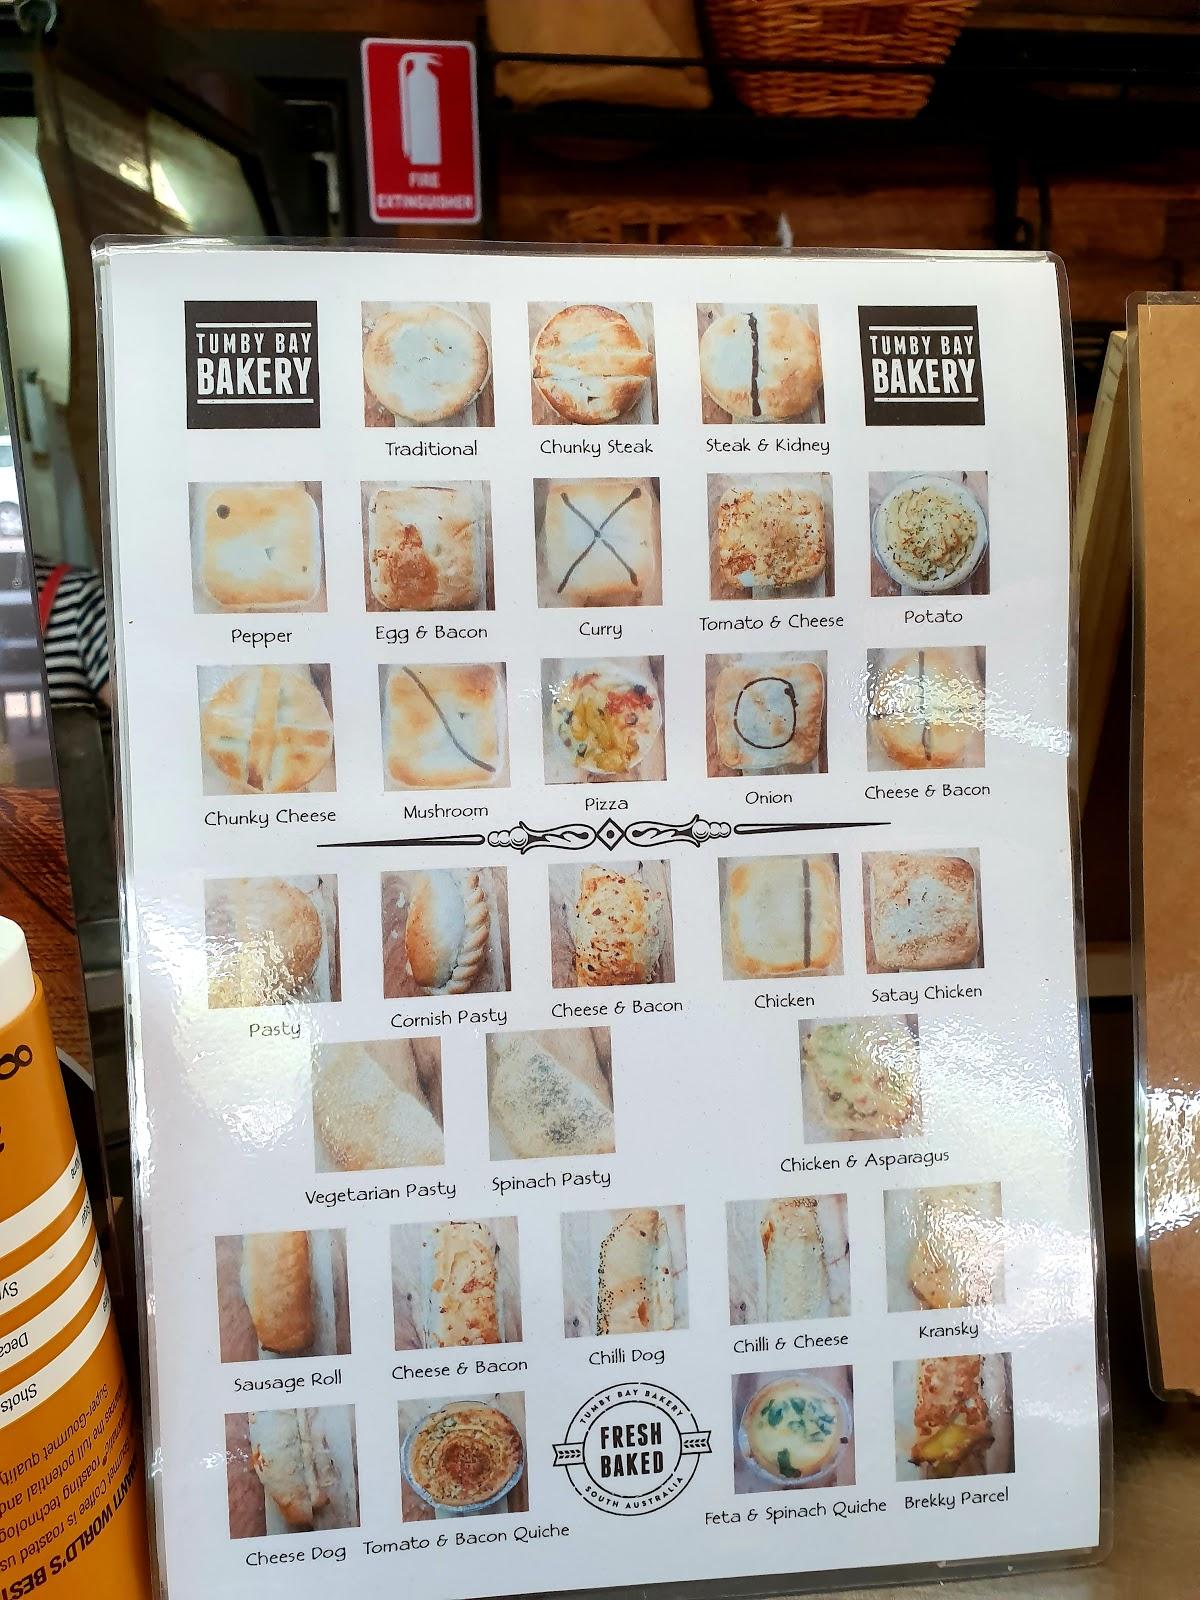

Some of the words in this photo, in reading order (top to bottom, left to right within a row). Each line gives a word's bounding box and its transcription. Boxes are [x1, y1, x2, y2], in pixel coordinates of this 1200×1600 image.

[408, 171, 440, 188] FIRE
[376, 193, 474, 210] EXTINGUISHER
[195, 332, 265, 354] TUMBY
[275, 332, 312, 354] BAY
[869, 335, 931, 355] TUMBY
[940, 335, 974, 355] BAY
[197, 357, 312, 395] BAKERY
[871, 358, 976, 394] BAKERY
[384, 439, 478, 457] Traditional
[539, 438, 601, 458] Chunky
[607, 438, 654, 454] Steak
[705, 437, 752, 453] Steak
[757, 438, 770, 452] &
[775, 436, 830, 456] Kidney
[698, 615, 764, 632] Tomato
[769, 615, 782, 629] &
[788, 612, 844, 629] Cheese
[904, 608, 963, 624] Potato
[231, 628, 293, 649] Pepper
[375, 625, 410, 645] Egg
[415, 625, 429, 640] &
[434, 624, 488, 639] Bacon
[579, 621, 623, 640] Curry
[745, 791, 793, 805] Onion
[864, 785, 919, 800] Cheese
[924, 784, 937, 798] &
[942, 783, 991, 797] Bacon
[403, 803, 489, 820] Mushroom
[585, 797, 629, 812] Pizza
[204, 809, 269, 829] Chunky
[275, 808, 337, 824] Cheese
[754, 992, 815, 1009] Chicken
[871, 987, 919, 1005] Satay
[923, 983, 983, 1000] Chicken
[390, 1009, 452, 1029] Cornish
[458, 1007, 508, 1026] Pasty
[551, 1002, 608, 1018] Cheese
[613, 1000, 626, 1015] &
[632, 999, 683, 1014] Bacon
[249, 1021, 301, 1040] Pasty
[780, 1155, 841, 1173] Chicken
[846, 1154, 858, 1169] &
[863, 1151, 950, 1171] Asparagus
[492, 1172, 556, 1192] Spinach
[561, 1169, 611, 1189] Pasty
[304, 1185, 400, 1208] Vegetarian
[406, 1180, 457, 1200] Pasty
[0, 1281, 19, 1300] Sy
[919, 1321, 979, 1339] Kransky
[733, 1335, 769, 1354] Chilli
[774, 1337, 787, 1351] &
[793, 1333, 849, 1349] Cheese
[588, 1347, 626, 1366] Chilli
[631, 1349, 665, 1365] Dog
[391, 1364, 451, 1380] Cheese
[456, 1361, 469, 1376] &
[475, 1360, 528, 1374] Bacon
[234, 1377, 305, 1394] Sausage
[311, 1368, 342, 1387] Roll
[0, 1383, 38, 1413] Shots
[579, 1395, 611, 1425] TUMBY
[617, 1389, 638, 1398] BAY
[644, 1390, 684, 1417] BAKERY
[600, 1422, 662, 1450] FRESH
[77, 1436, 92, 1460] full
[600, 1451, 664, 1478] BAKED
[26, 1450, 75, 1502] potential
[62, 1456, 101, 1500] roasting
[79, 1479, 107, 1515] Coffee
[584, 1485, 619, 1508] SOUTH
[625, 1476, 684, 1509] AUSTRALIA
[904, 1492, 956, 1511] Brekky
[961, 1485, 1009, 1505] Parcel
[66, 1511, 78, 1527] is
[705, 1510, 741, 1526] Feta
[746, 1508, 759, 1522] &
[765, 1502, 827, 1526] Spinach
[832, 1498, 887, 1519] Quiche
[19, 1521, 65, 1563] roasted
[49, 1503, 114, 1575] WORLD'S
[362, 1536, 430, 1556] Tomato
[436, 1533, 449, 1548] &
[454, 1530, 508, 1546] Bacon
[513, 1522, 570, 1543] Quiche
[245, 1551, 305, 1567] Cheese
[311, 1546, 347, 1563] Dog
[1, 1565, 48, 1600] BEST
